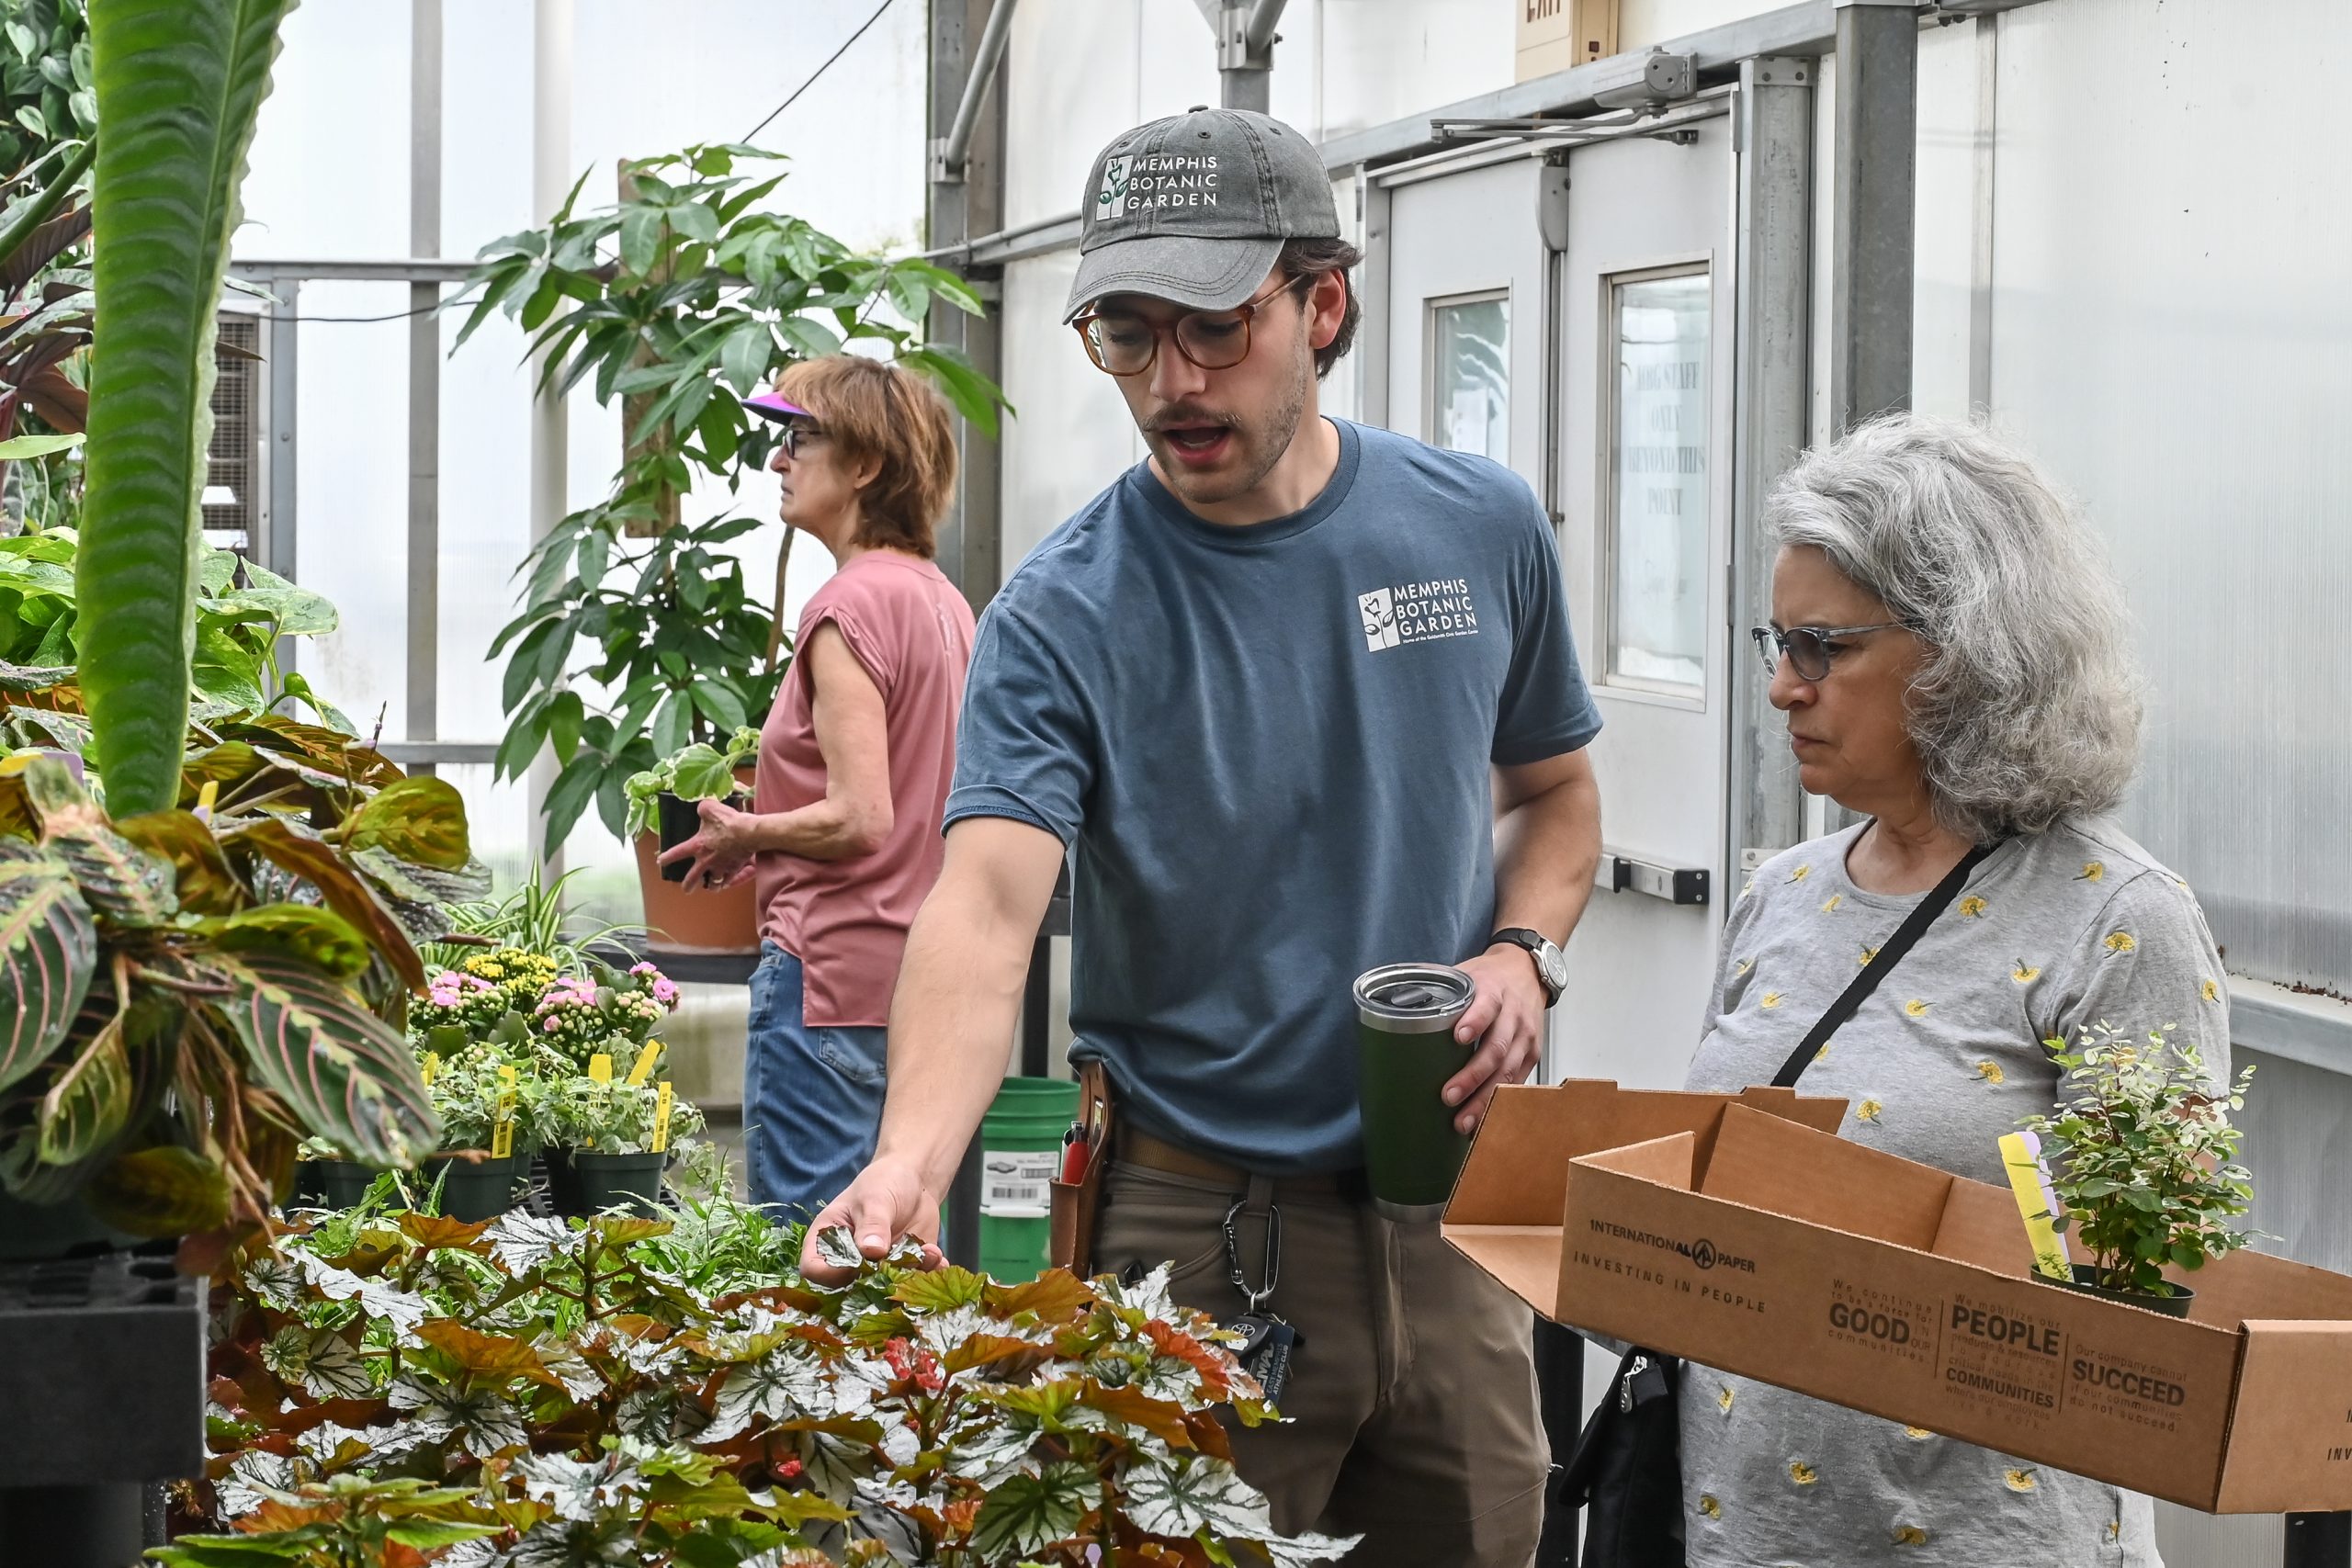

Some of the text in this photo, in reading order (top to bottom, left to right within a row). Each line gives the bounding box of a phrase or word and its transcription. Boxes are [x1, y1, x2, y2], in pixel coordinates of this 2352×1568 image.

[1134, 156, 1217, 172] MEMPHIS
[1130, 174, 1217, 191] BOTANIC
[1127, 193, 1216, 209] GARDEN
[1394, 579, 1468, 602] MEMPHIS
[1396, 596, 1473, 620] BOTANIC
[1399, 613, 1477, 637] GARDEN
[1589, 1219, 1756, 1273] INTERNATIONAL PAPER
[1574, 1250, 1766, 1314] INVESTING IN PEOPLE
[1833, 1278, 1932, 1314] We continue
[1831, 1291, 1842, 1301] to
[1880, 1303, 1909, 1318] force
[1955, 1293, 2061, 1330] We mobilize our
[1829, 1303, 1910, 1344] GOOD
[1951, 1304, 2060, 1357] PEOPLE
[1272, 1344, 1289, 1395] ATHLETIC CLUB
[2076, 1344, 2188, 1382] Our company cannot
[1946, 1367, 2054, 1409] COMMUNITIES
[2073, 1359, 2185, 1406] SUCCEED
[2092, 1403, 2113, 1416] not
